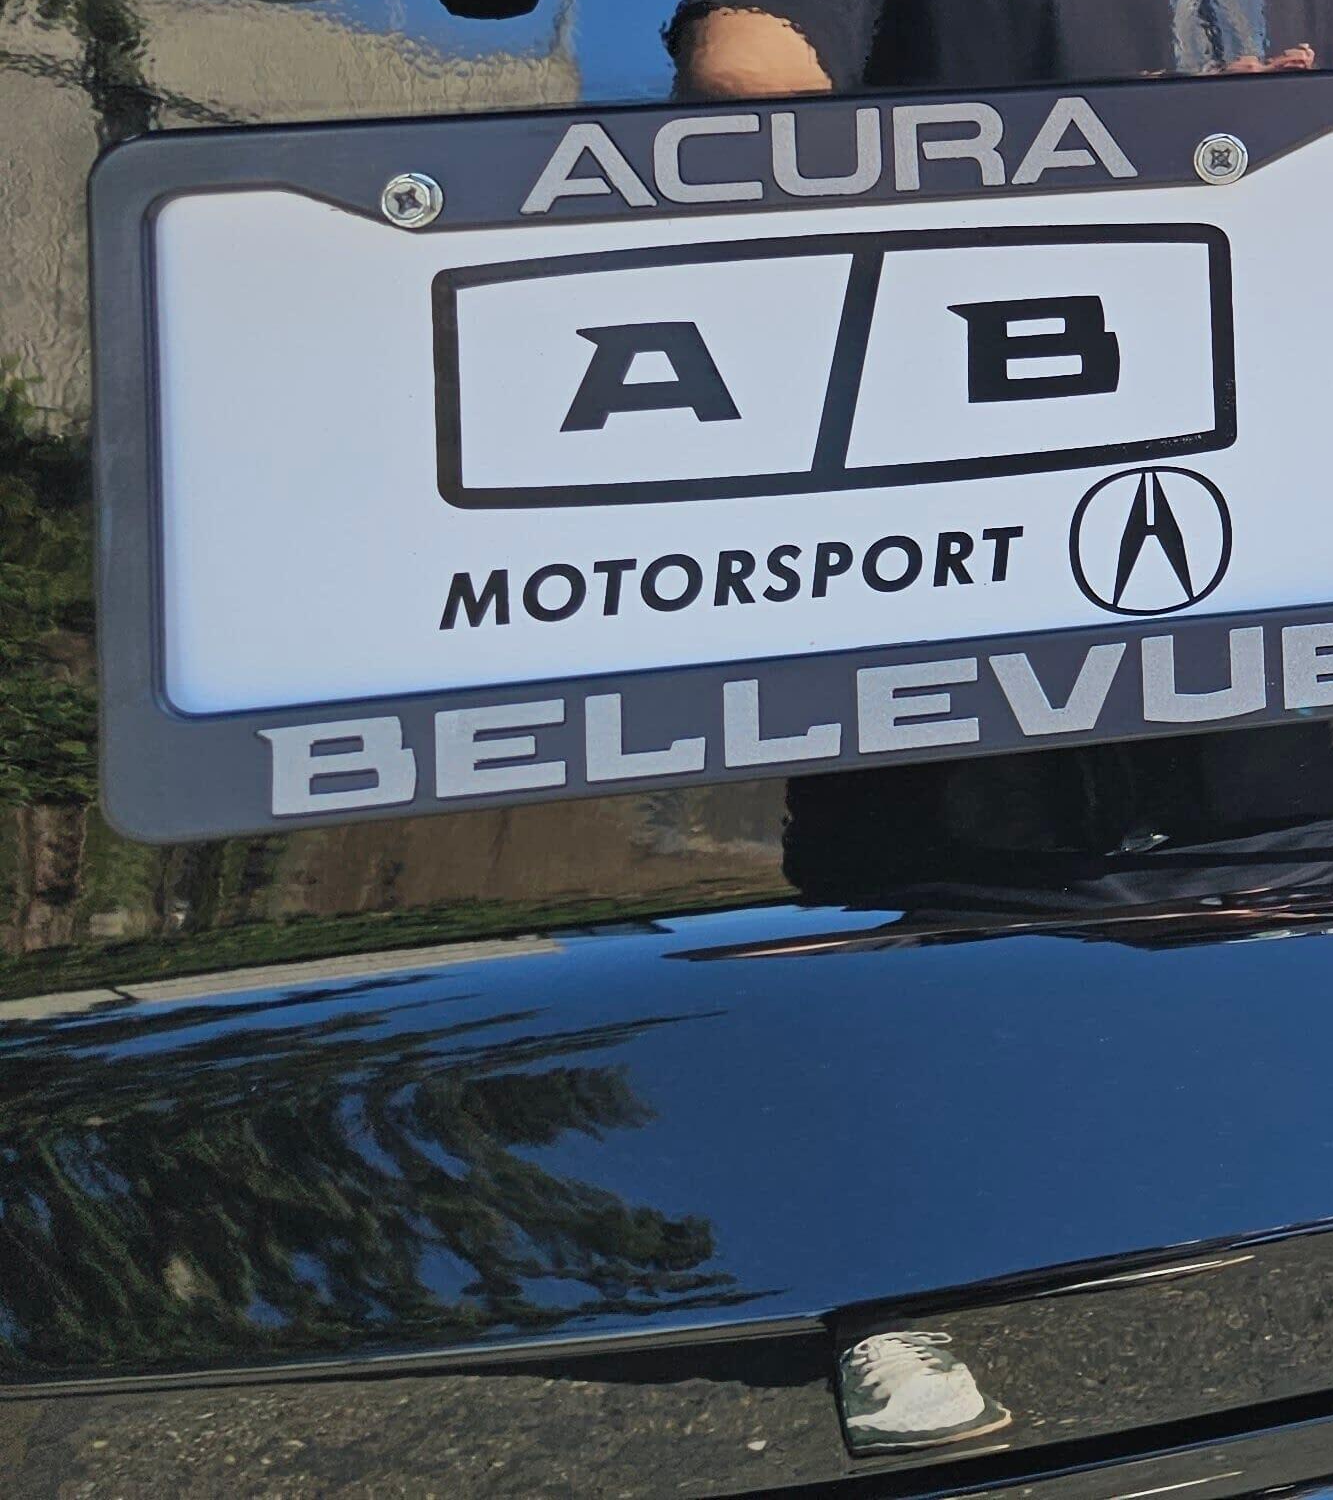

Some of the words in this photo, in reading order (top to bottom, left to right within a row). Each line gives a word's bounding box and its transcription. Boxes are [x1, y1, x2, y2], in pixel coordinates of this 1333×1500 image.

[520, 97, 1136, 213] ACURA
[559, 320, 740, 431] A
[946, 295, 1121, 402] B
[438, 525, 1024, 630] MOTORSPORT
